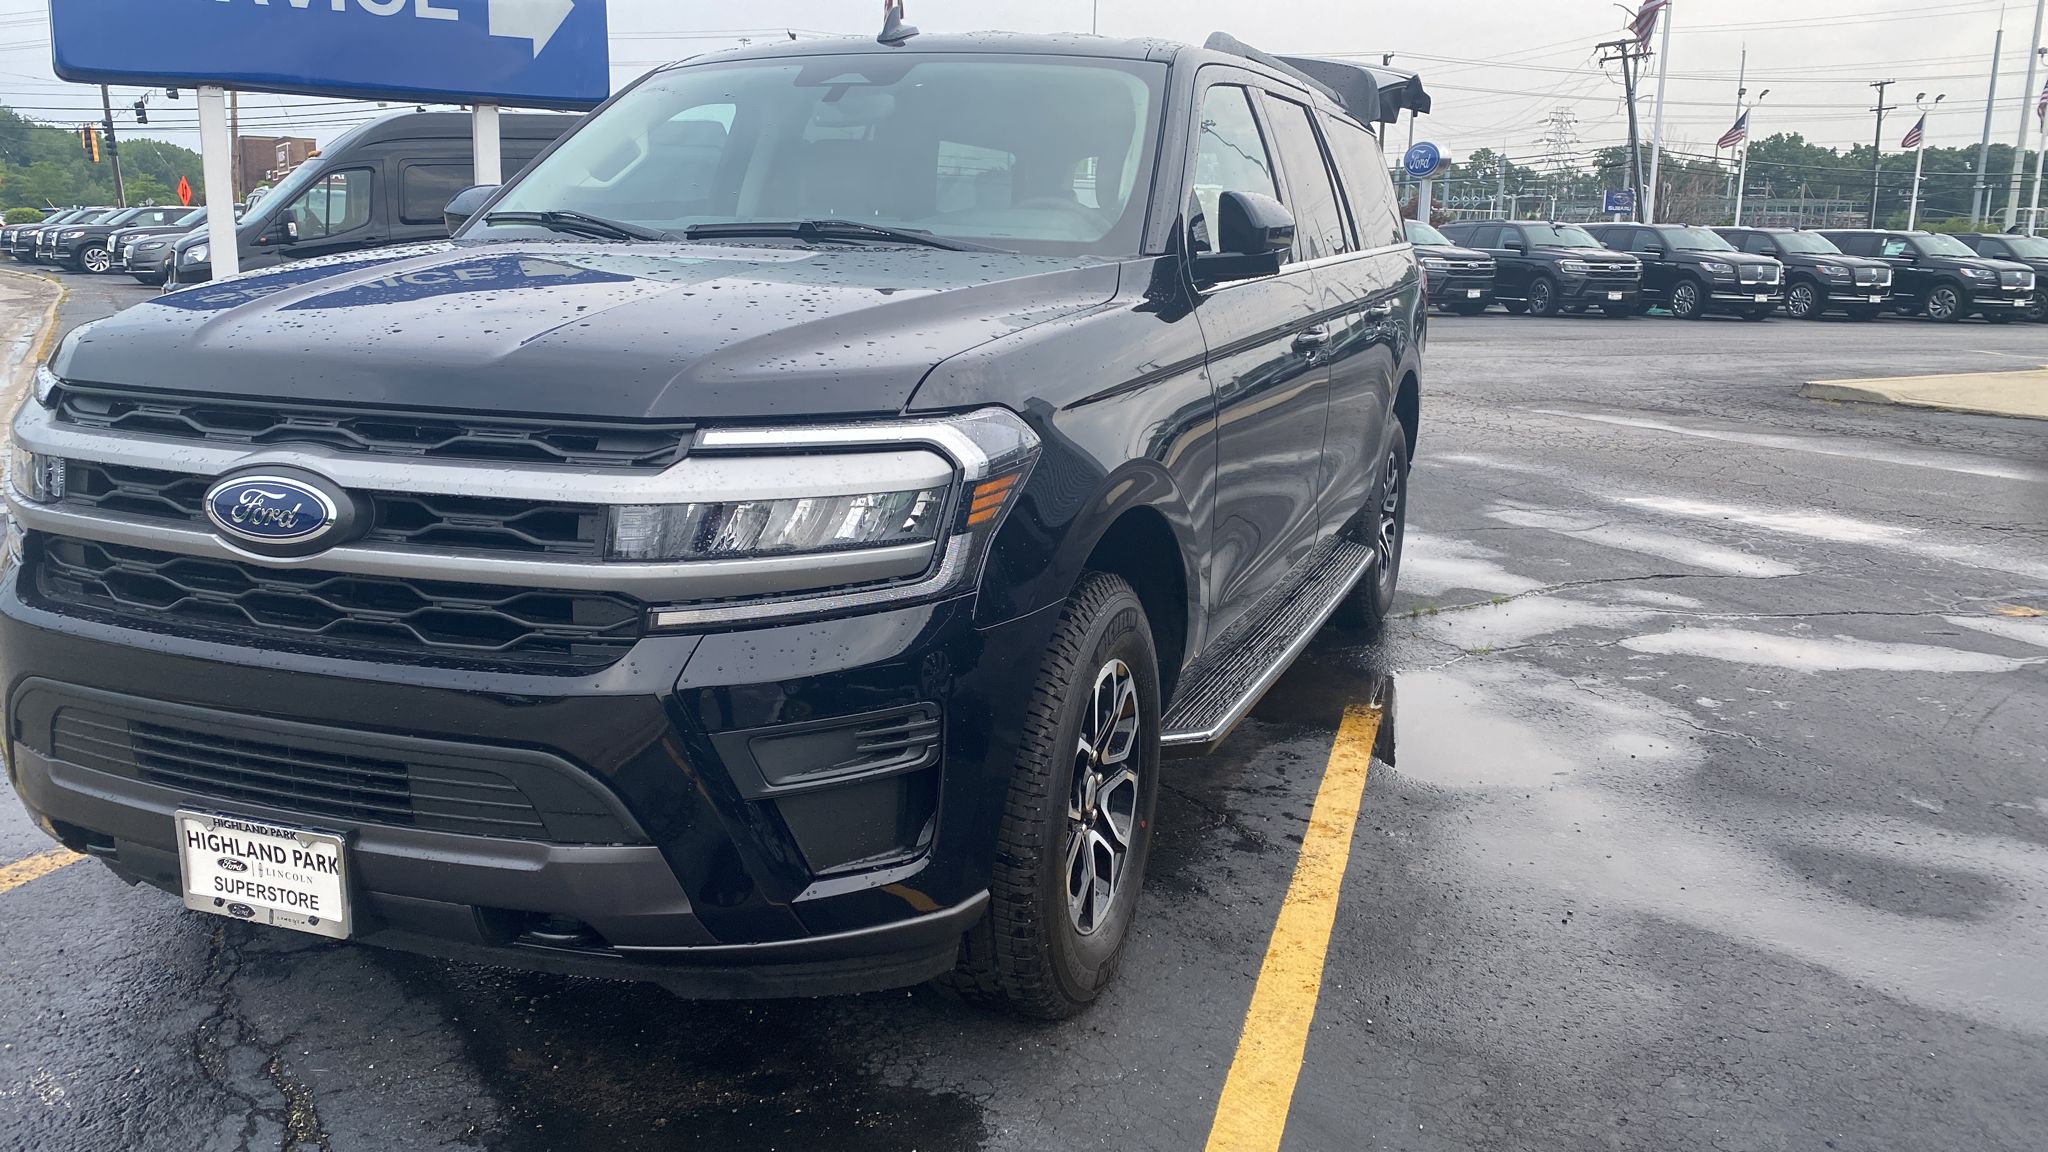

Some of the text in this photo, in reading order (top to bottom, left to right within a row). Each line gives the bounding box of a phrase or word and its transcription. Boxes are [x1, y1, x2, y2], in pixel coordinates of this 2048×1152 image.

[1410, 149, 1432, 169] Ford
[231, 488, 302, 529] Ford
[212, 818, 297, 841] HIGHLAND PARK
[186, 830, 339, 876] HIGHLAND PARK
[221, 858, 313, 884] Ford LINCOLN
[214, 876, 320, 911] SUPERSTORE
[231, 903, 250, 917] Ford
